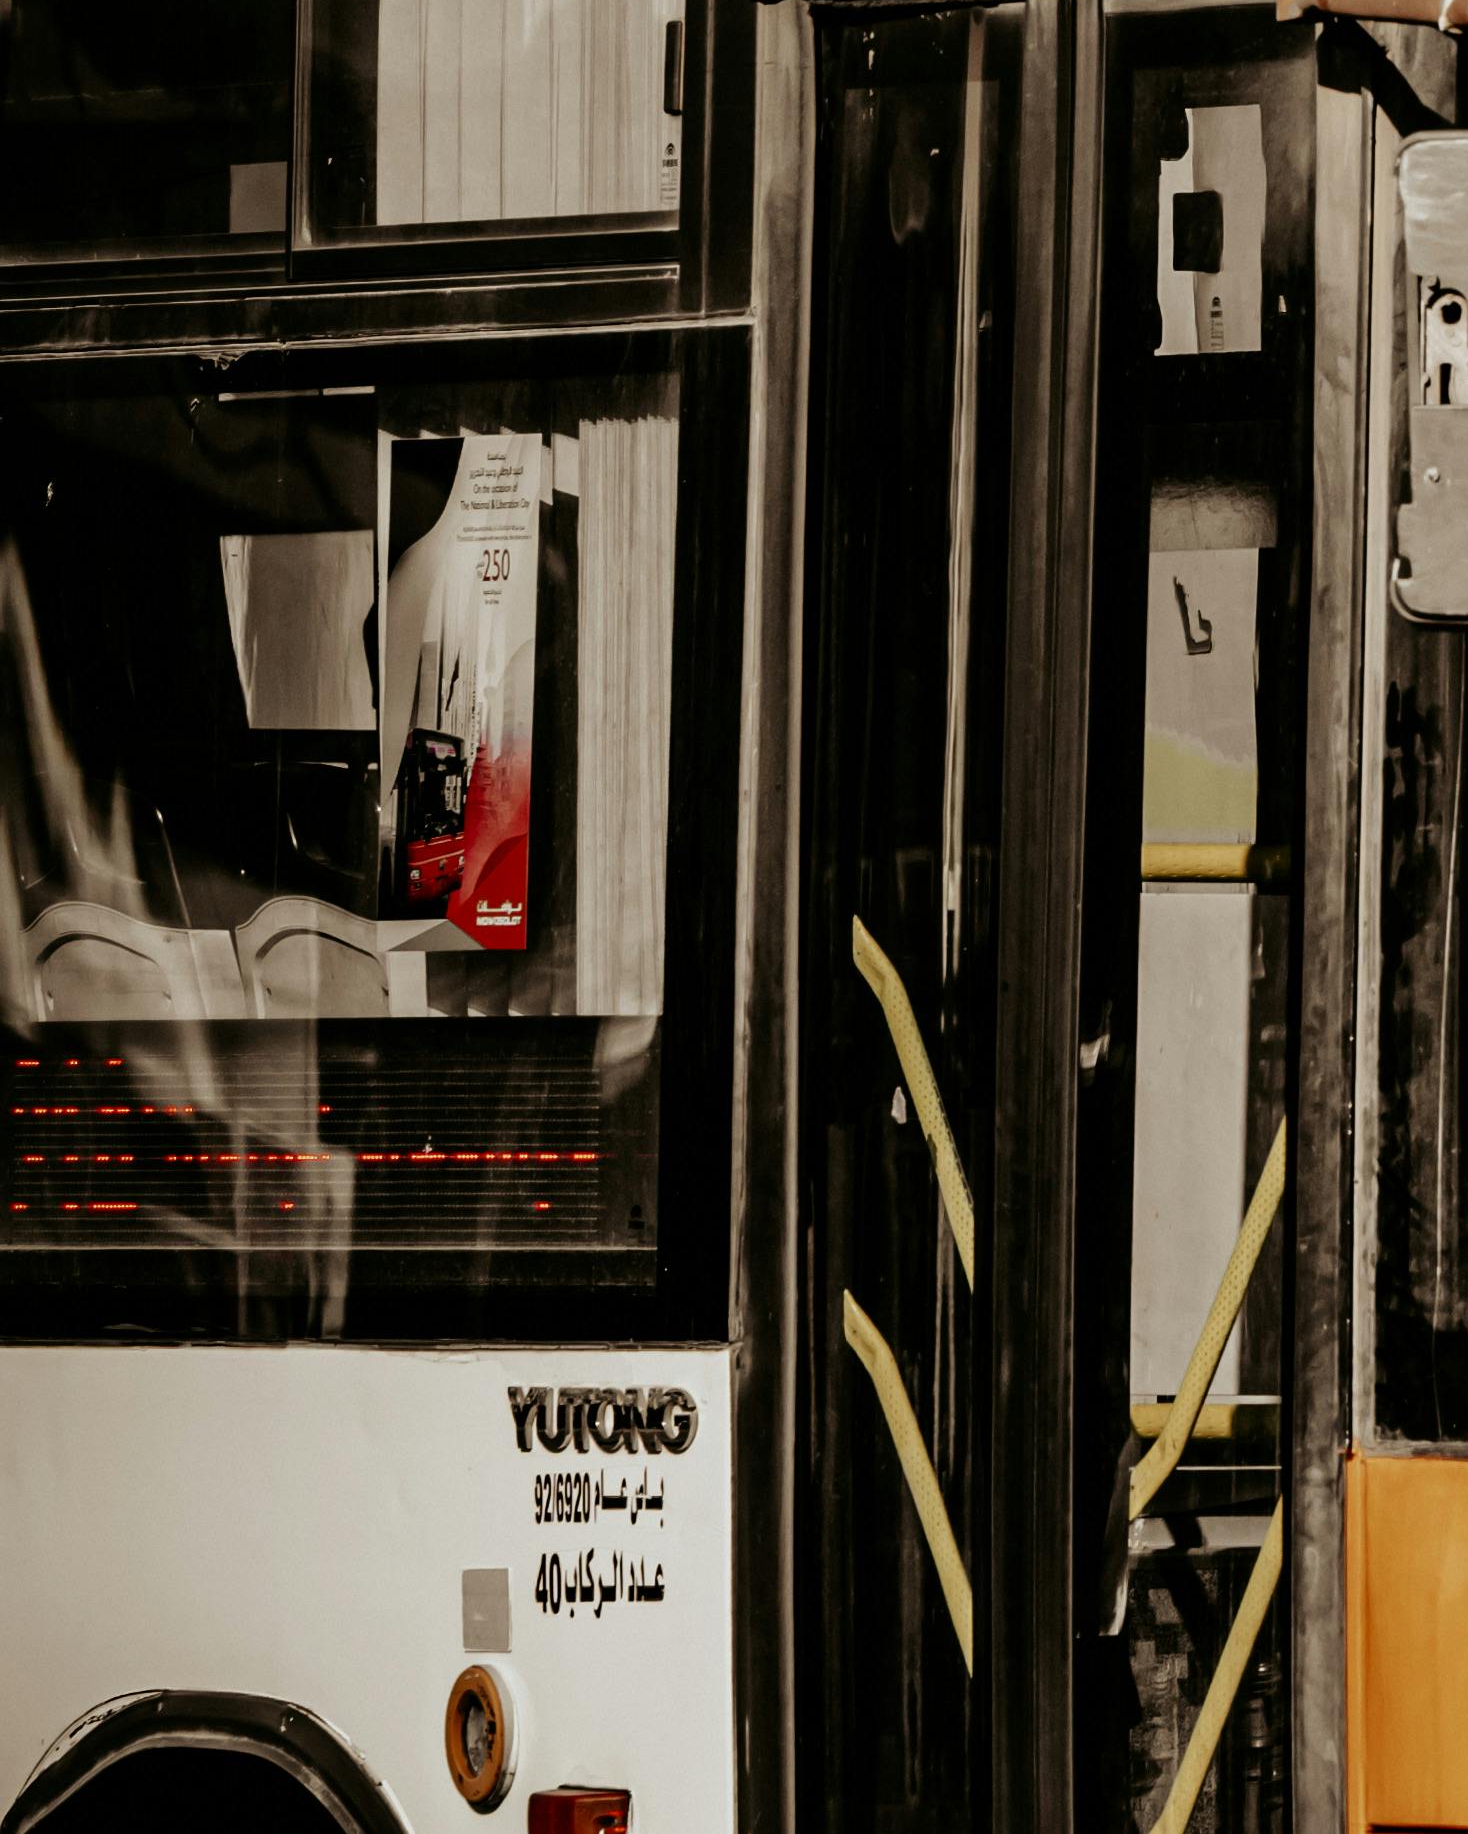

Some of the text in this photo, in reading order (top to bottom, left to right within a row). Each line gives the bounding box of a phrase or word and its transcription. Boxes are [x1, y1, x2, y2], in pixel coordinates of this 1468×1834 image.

[482, 549, 511, 582] 250
[507, 1386, 699, 1454] YUTONG
[534, 1472, 591, 1525] 92/6920
[534, 1552, 562, 1615] 40
